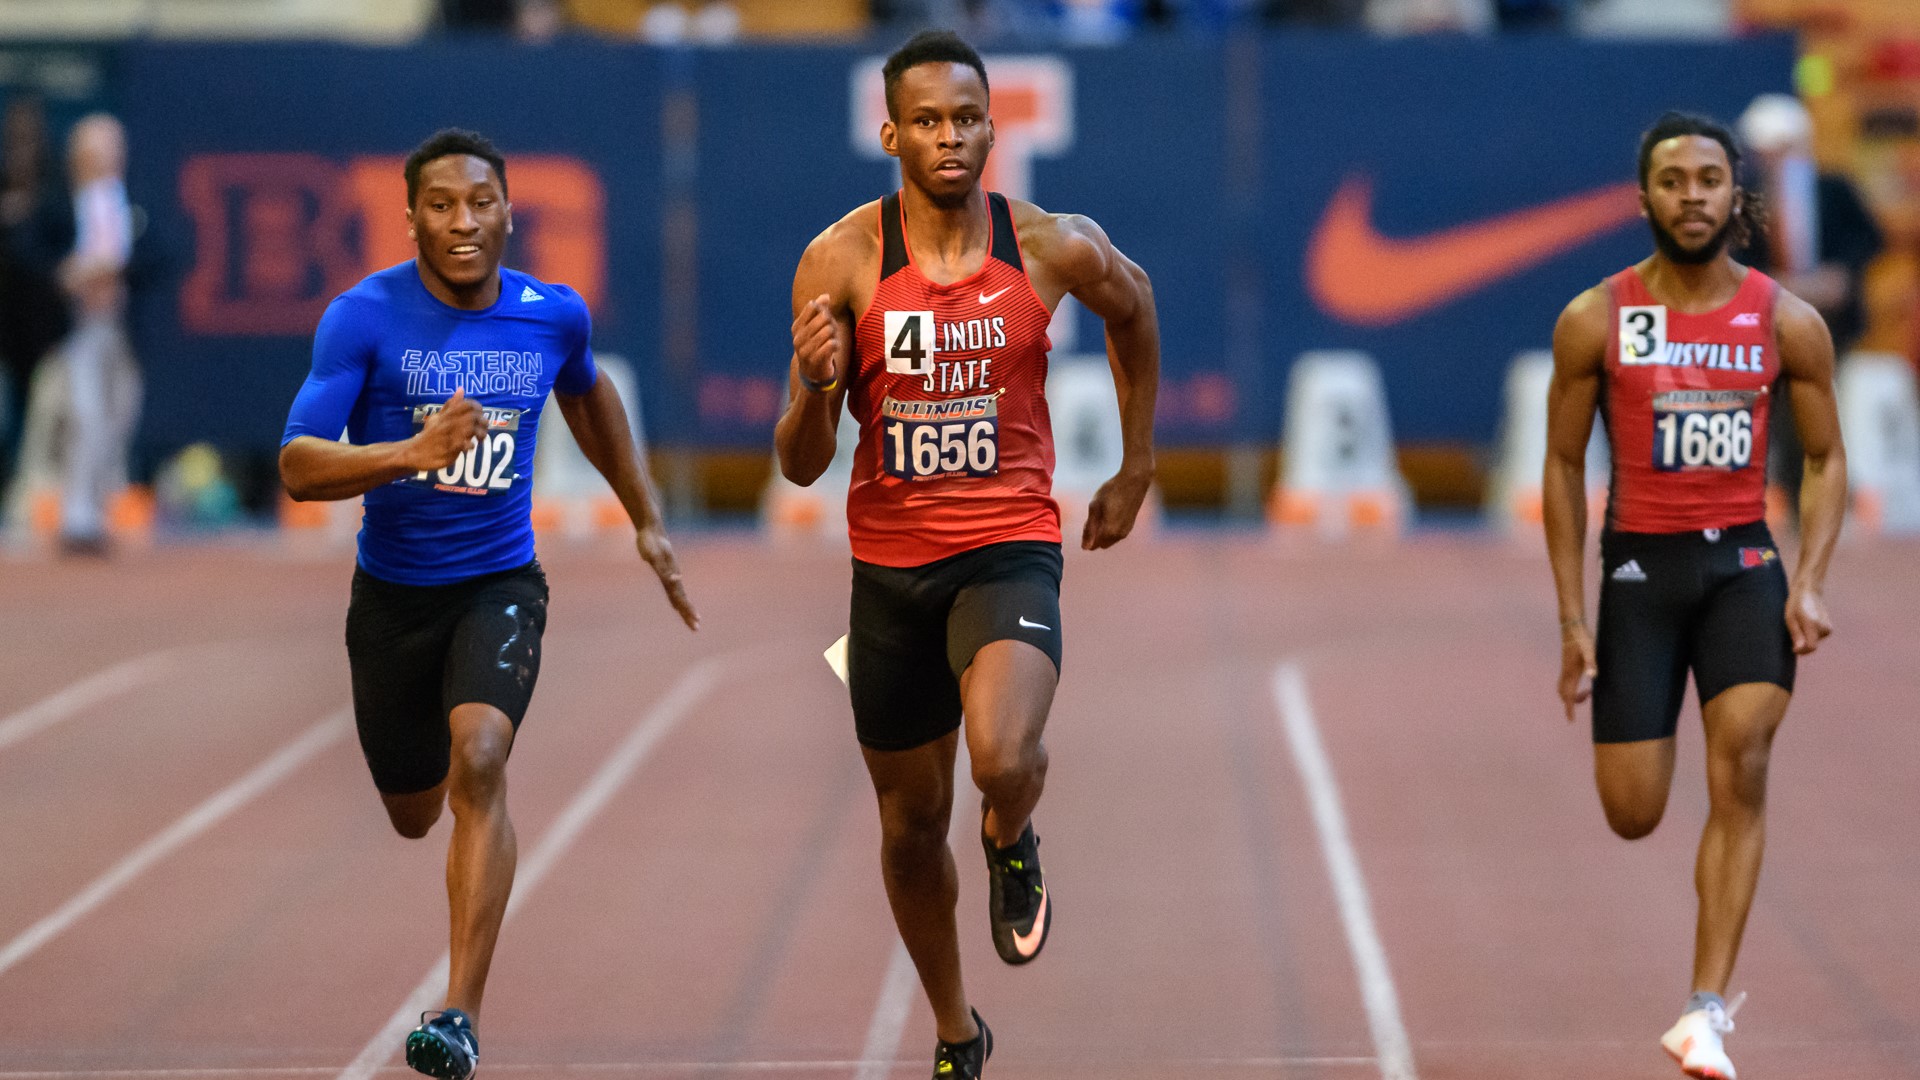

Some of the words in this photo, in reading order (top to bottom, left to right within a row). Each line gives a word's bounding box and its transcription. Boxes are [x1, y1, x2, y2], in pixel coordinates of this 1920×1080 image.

[890, 315, 927, 370] 4
[933, 316, 1006, 352] LINOIS
[1626, 310, 1656, 358] 3
[401, 349, 543, 375] EASTERN
[923, 359, 993, 392] STATE
[406, 371, 538, 397] ILLINOIS
[889, 398, 988, 420] ILLINOIS
[887, 420, 996, 476] 1656
[1657, 409, 1752, 467] 1686
